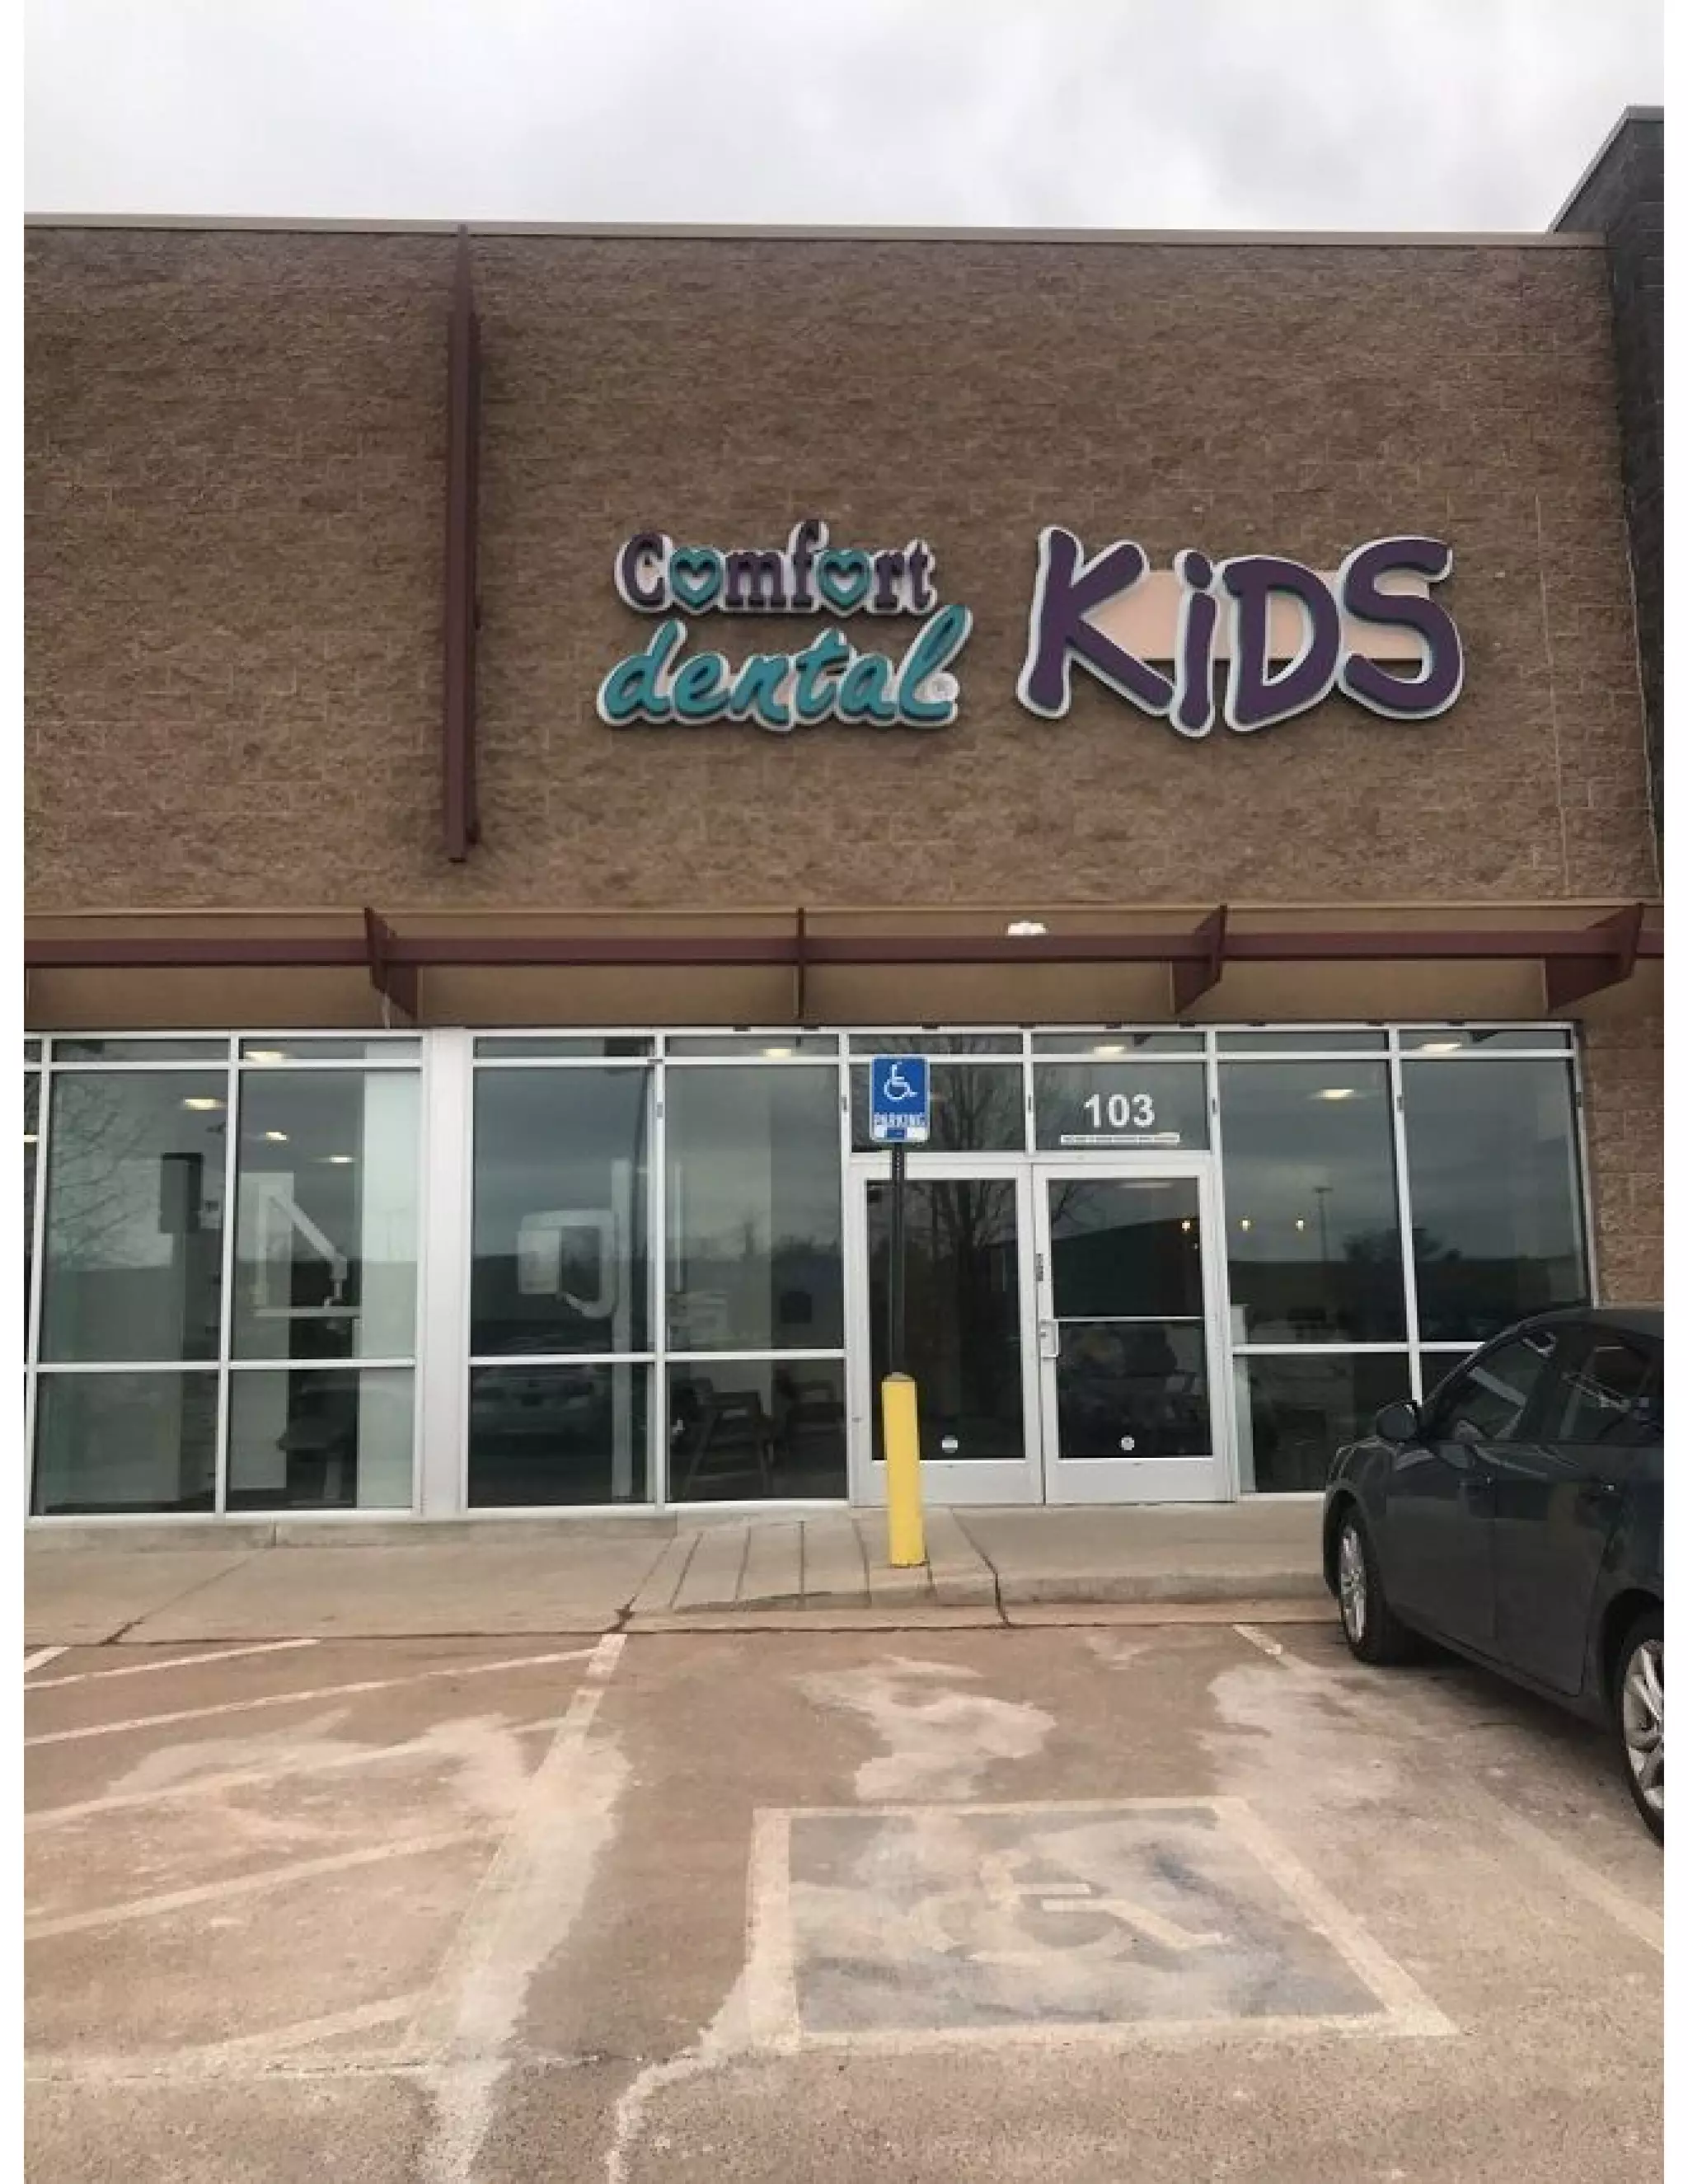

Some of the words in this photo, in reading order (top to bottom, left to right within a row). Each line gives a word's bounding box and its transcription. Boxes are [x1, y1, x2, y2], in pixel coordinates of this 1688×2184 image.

[618, 518, 936, 613] Comfort
[600, 603, 972, 729] dental
[1084, 1094, 1155, 1128] 103
